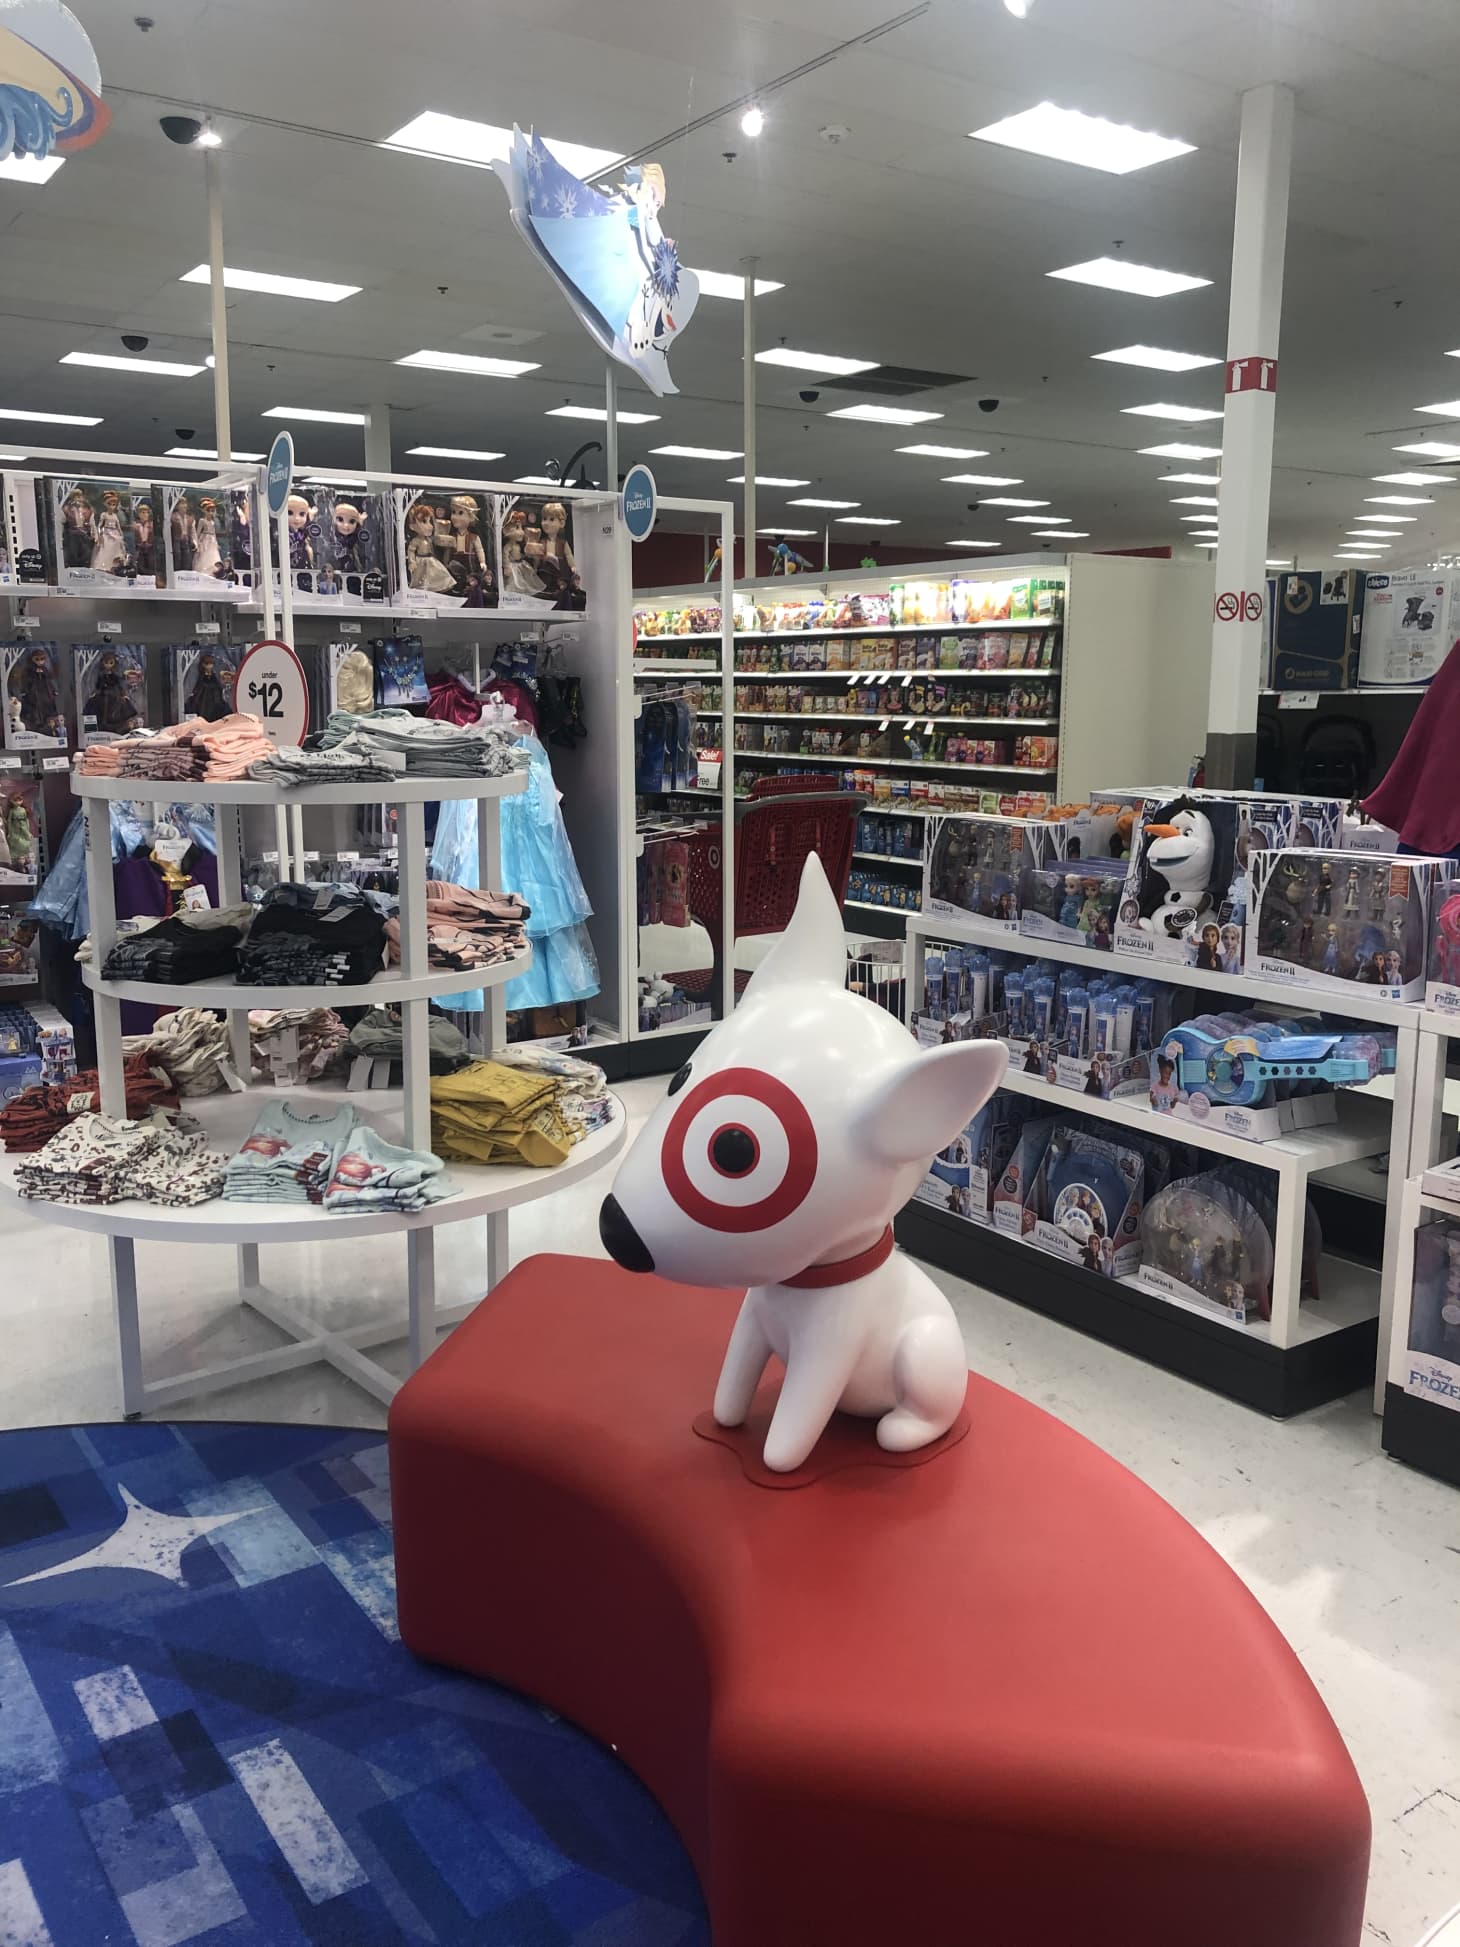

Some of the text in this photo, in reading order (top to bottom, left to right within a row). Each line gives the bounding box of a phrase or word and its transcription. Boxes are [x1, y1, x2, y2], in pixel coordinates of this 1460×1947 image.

[626, 499, 646, 513] FROZEN
[261, 671, 278, 679] under
[248, 680, 284, 718] $12
[700, 749, 720, 761] Sale!
[1117, 935, 1154, 951] FROZEN II
[1260, 962, 1289, 974] FROZEN
